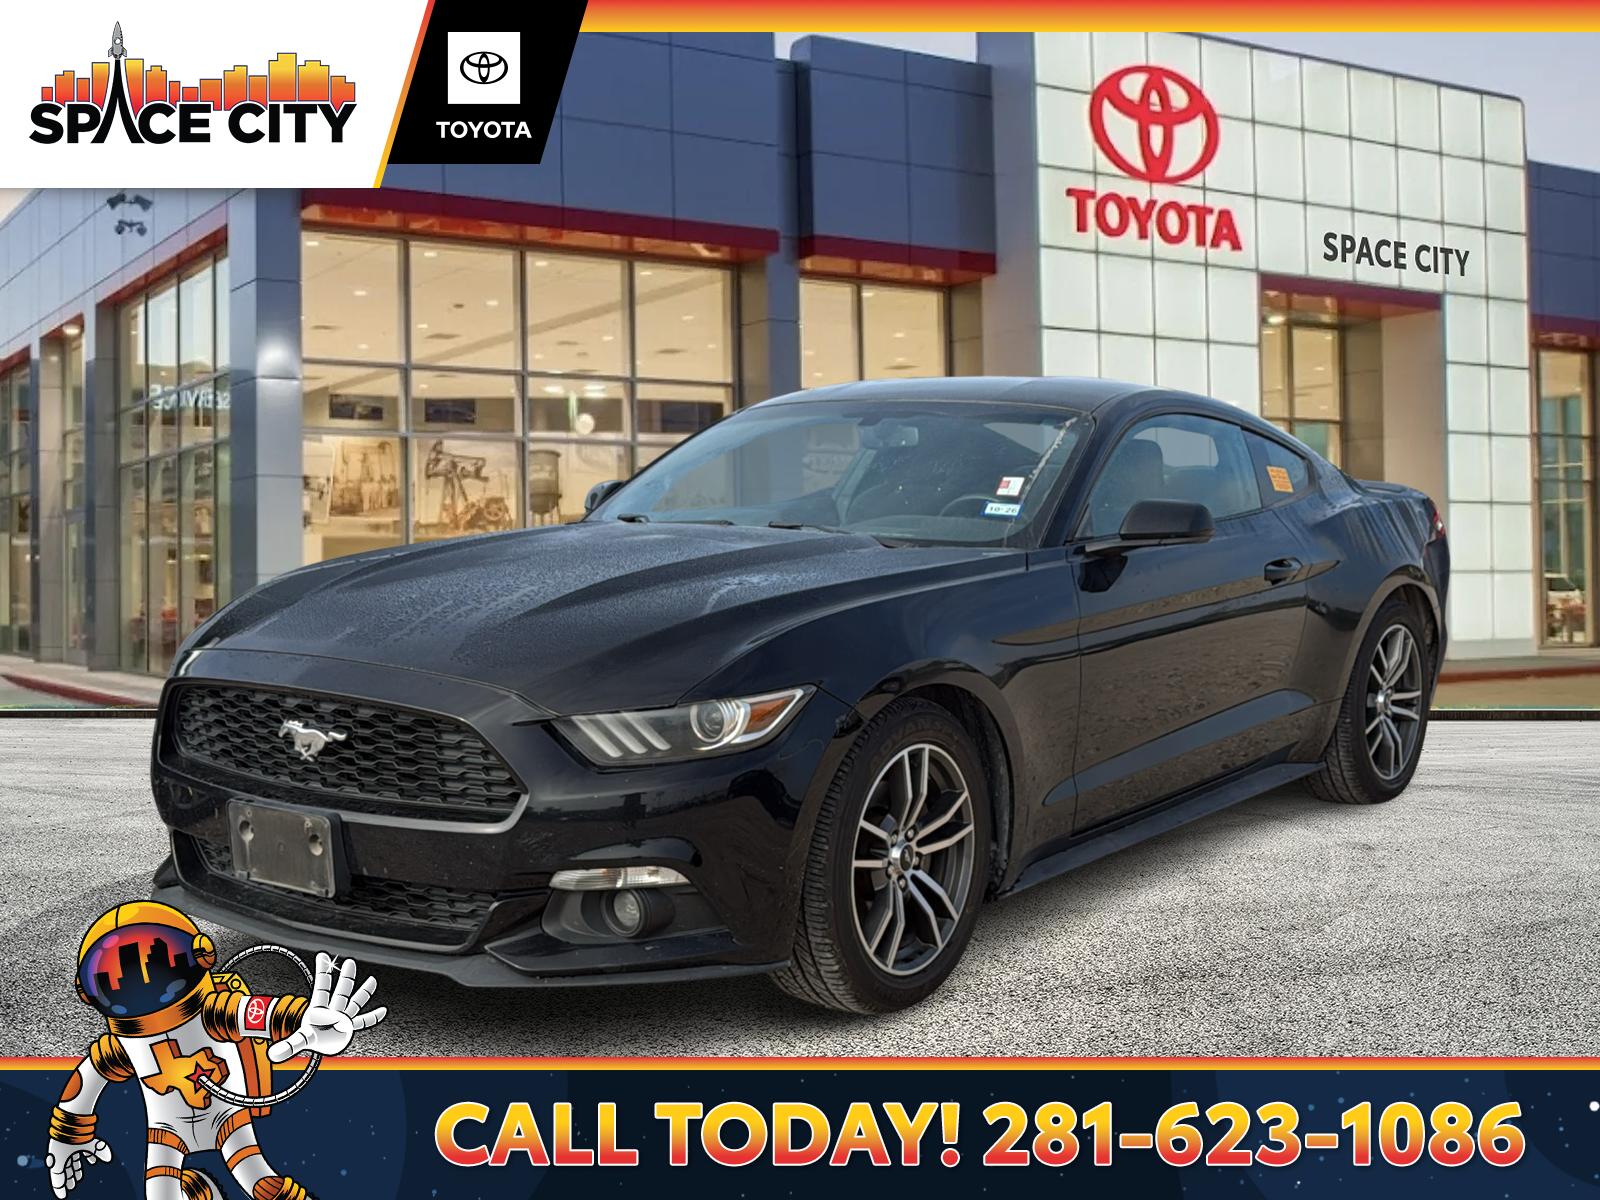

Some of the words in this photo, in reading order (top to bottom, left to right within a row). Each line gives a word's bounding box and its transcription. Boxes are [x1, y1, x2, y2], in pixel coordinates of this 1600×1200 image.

[1066, 187, 1242, 251] TOYOTA
[1322, 232, 1407, 270] SPACE
[1414, 244, 1470, 277] CITY
